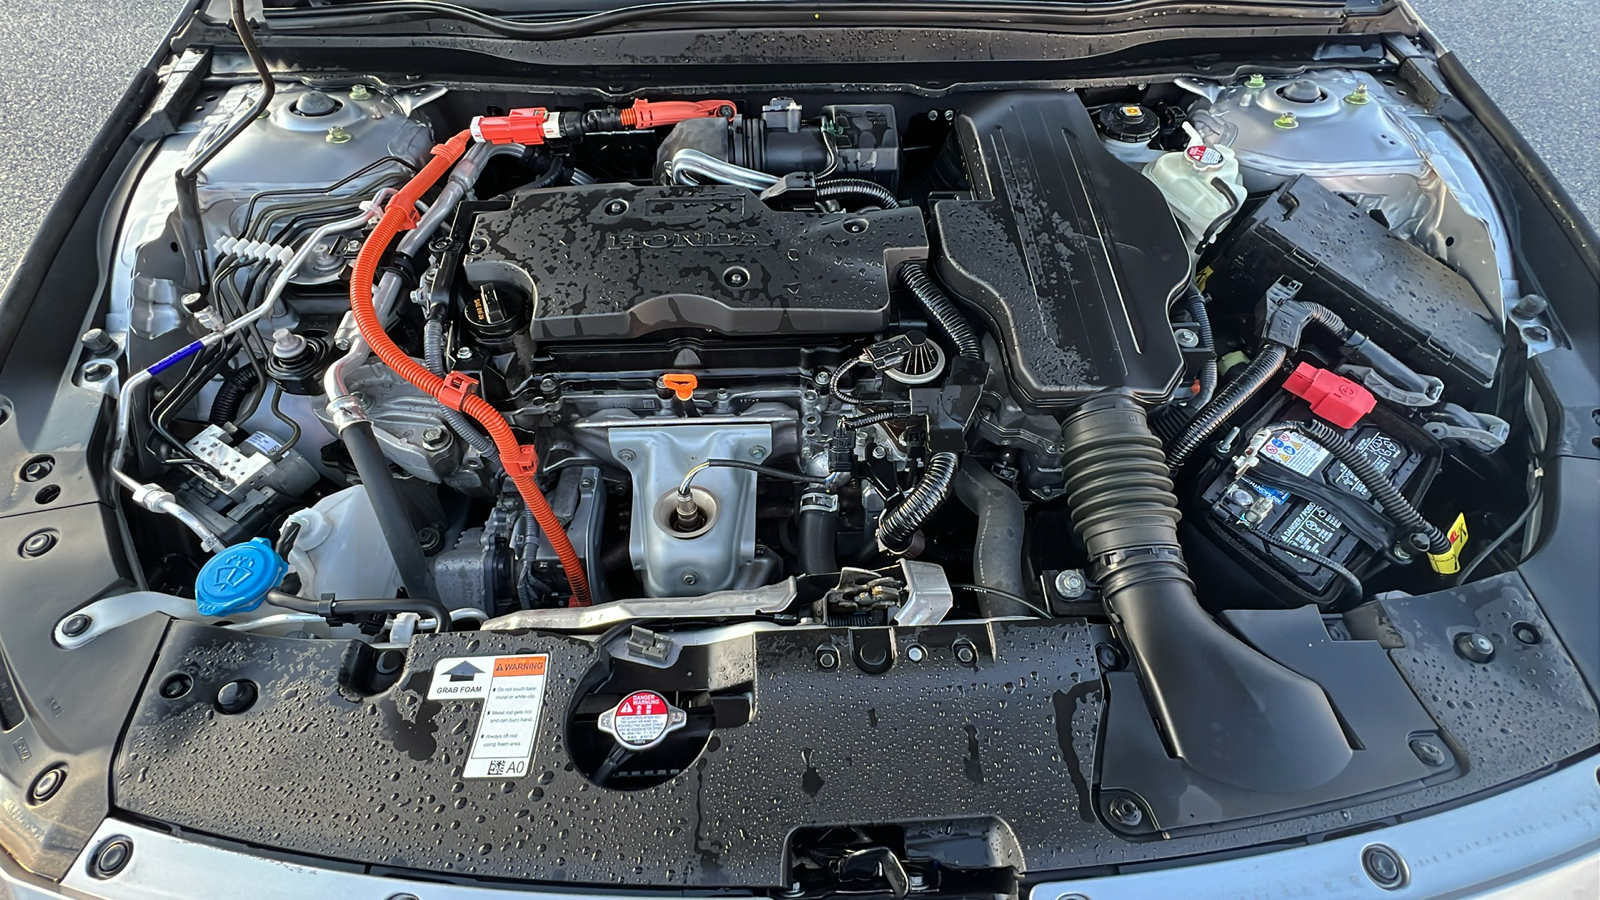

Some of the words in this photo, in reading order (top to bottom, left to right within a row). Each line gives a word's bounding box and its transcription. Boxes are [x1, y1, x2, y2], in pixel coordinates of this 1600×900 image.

[608, 232, 775, 250] HONDA
[1284, 517, 1302, 537] DANGER
[1302, 502, 1315, 516] POISO
[505, 662, 544, 671] WARNING
[506, 761, 525, 773] A0
